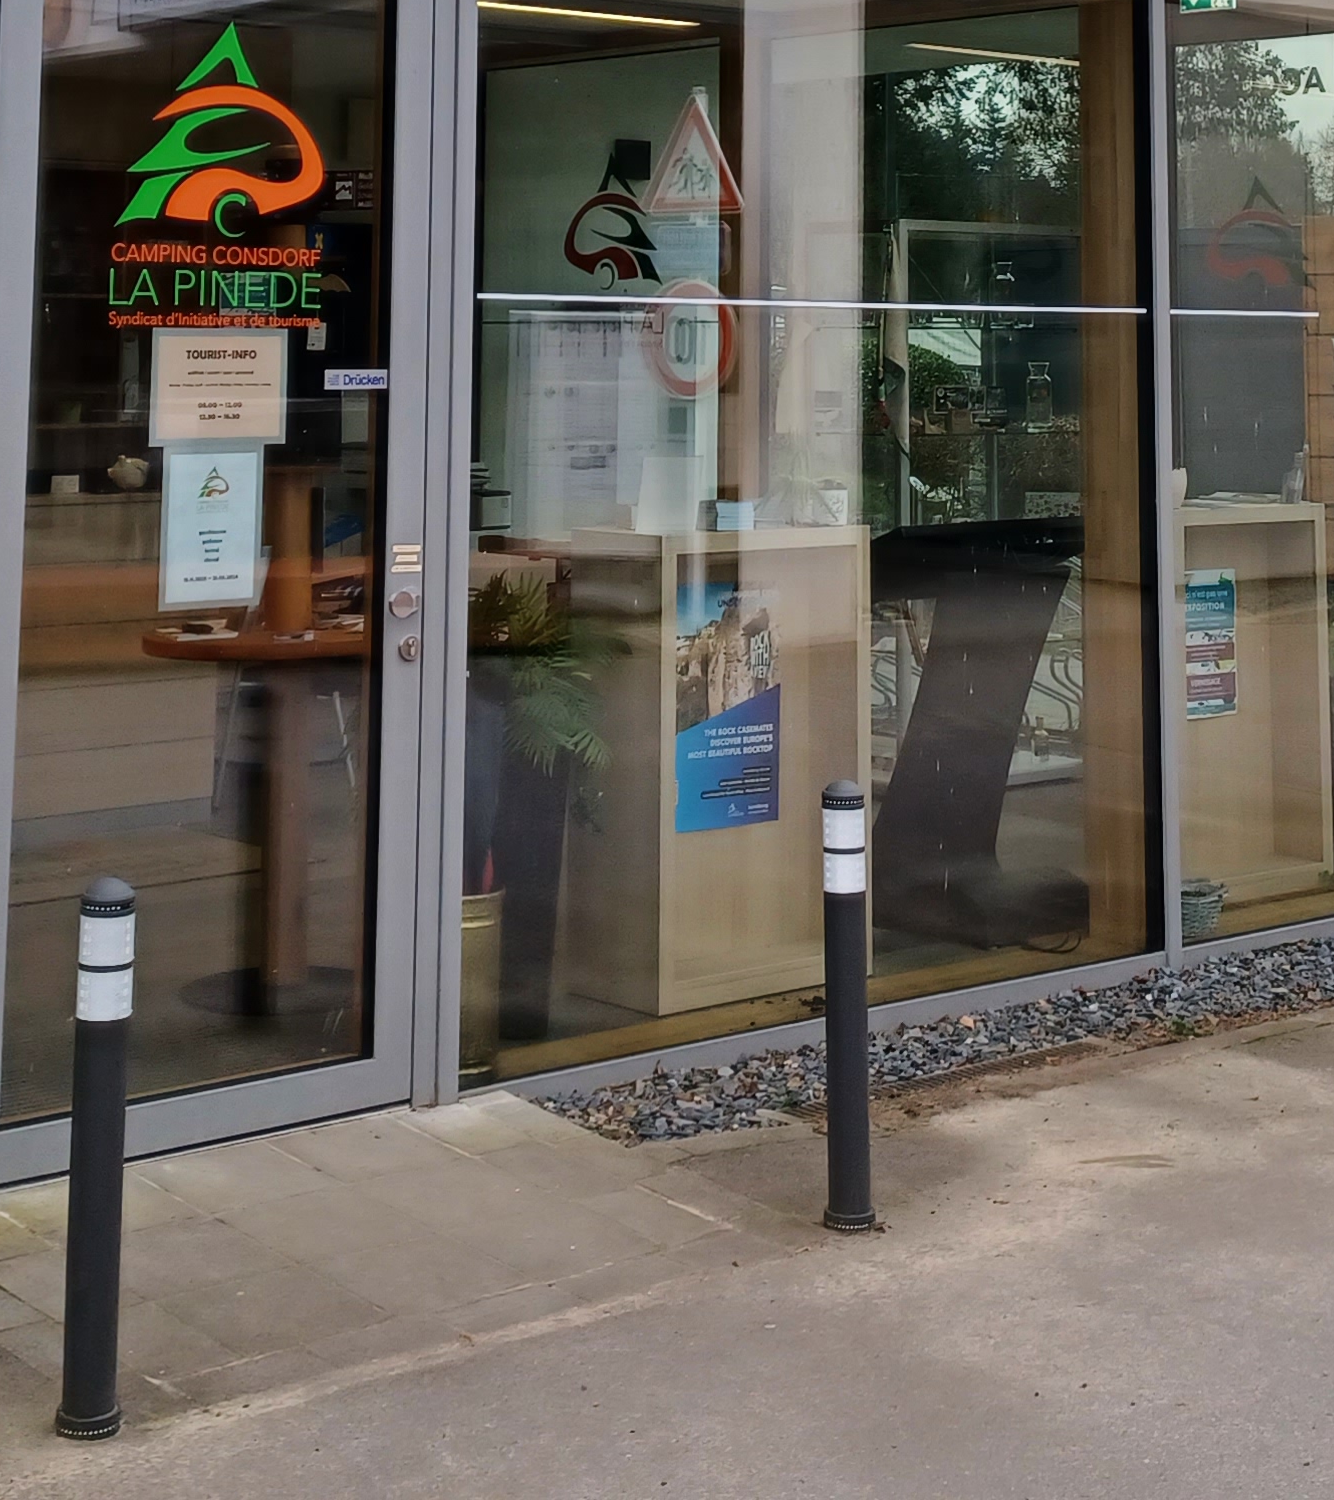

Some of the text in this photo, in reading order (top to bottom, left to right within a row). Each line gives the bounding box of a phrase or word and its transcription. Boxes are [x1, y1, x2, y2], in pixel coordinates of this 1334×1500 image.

[110, 242, 322, 268] CAMPING CONSDORF
[108, 267, 322, 309] LA PINEDE
[108, 311, 163, 328] Syndicat
[233, 314, 247, 327] et
[249, 313, 266, 327] de
[268, 314, 321, 328] tourisme
[186, 349, 257, 360] TOURIST-INFO
[343, 374, 385, 386] Drücken
